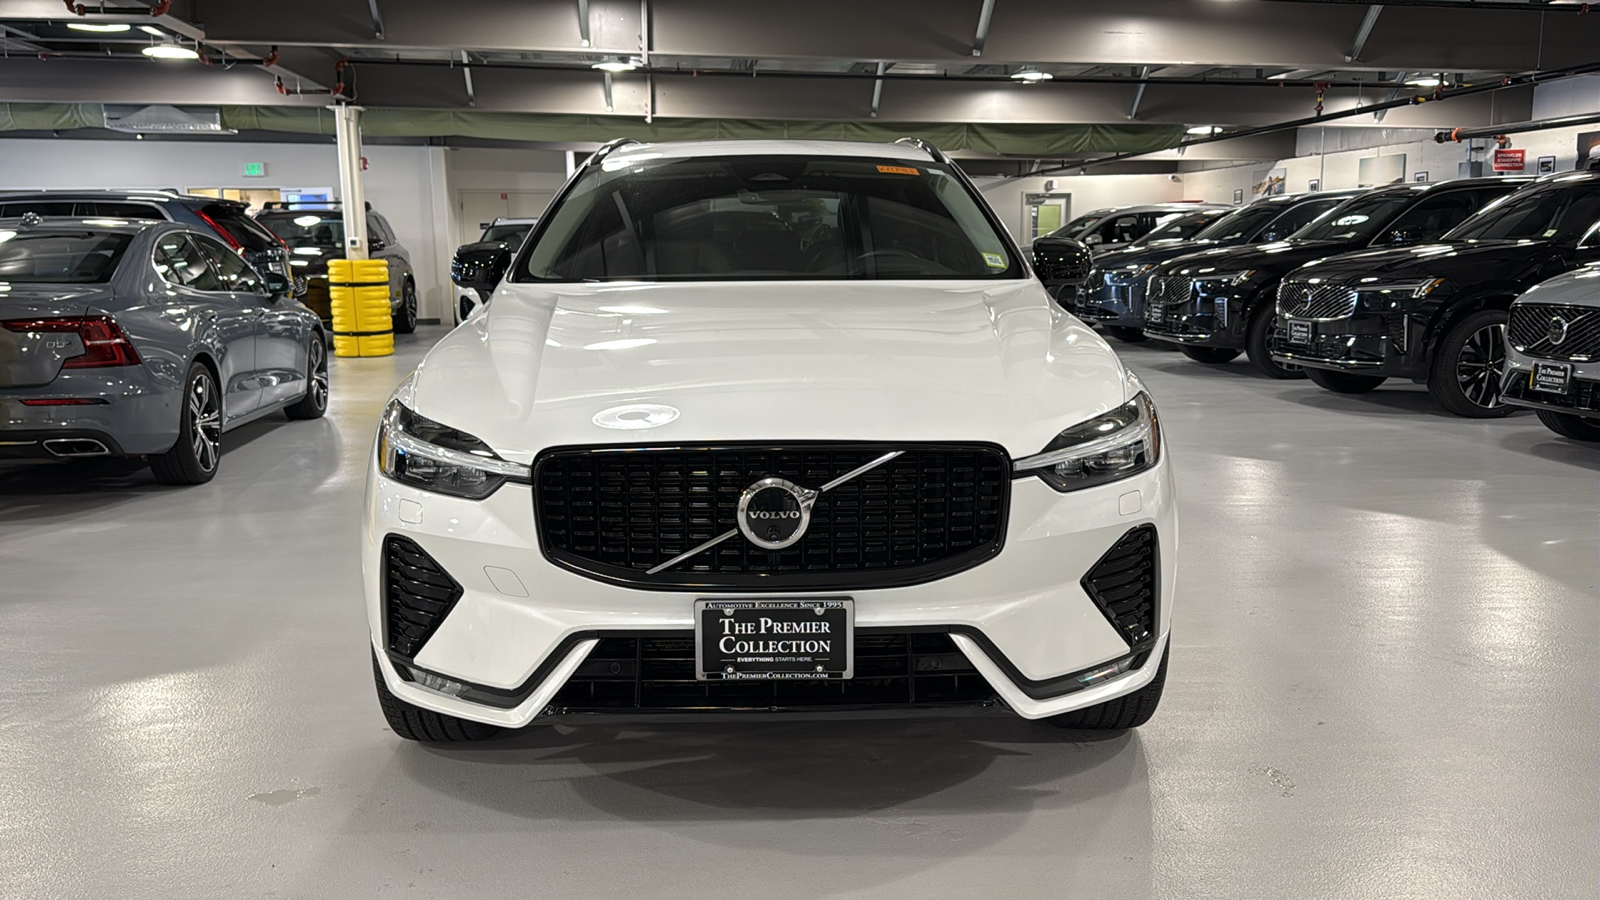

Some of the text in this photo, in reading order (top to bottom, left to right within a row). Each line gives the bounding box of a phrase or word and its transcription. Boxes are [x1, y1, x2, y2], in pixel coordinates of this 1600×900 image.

[748, 510, 800, 519] VOLVO
[719, 617, 831, 634] THE PREMIER
[719, 636, 831, 653] COLLECTION
